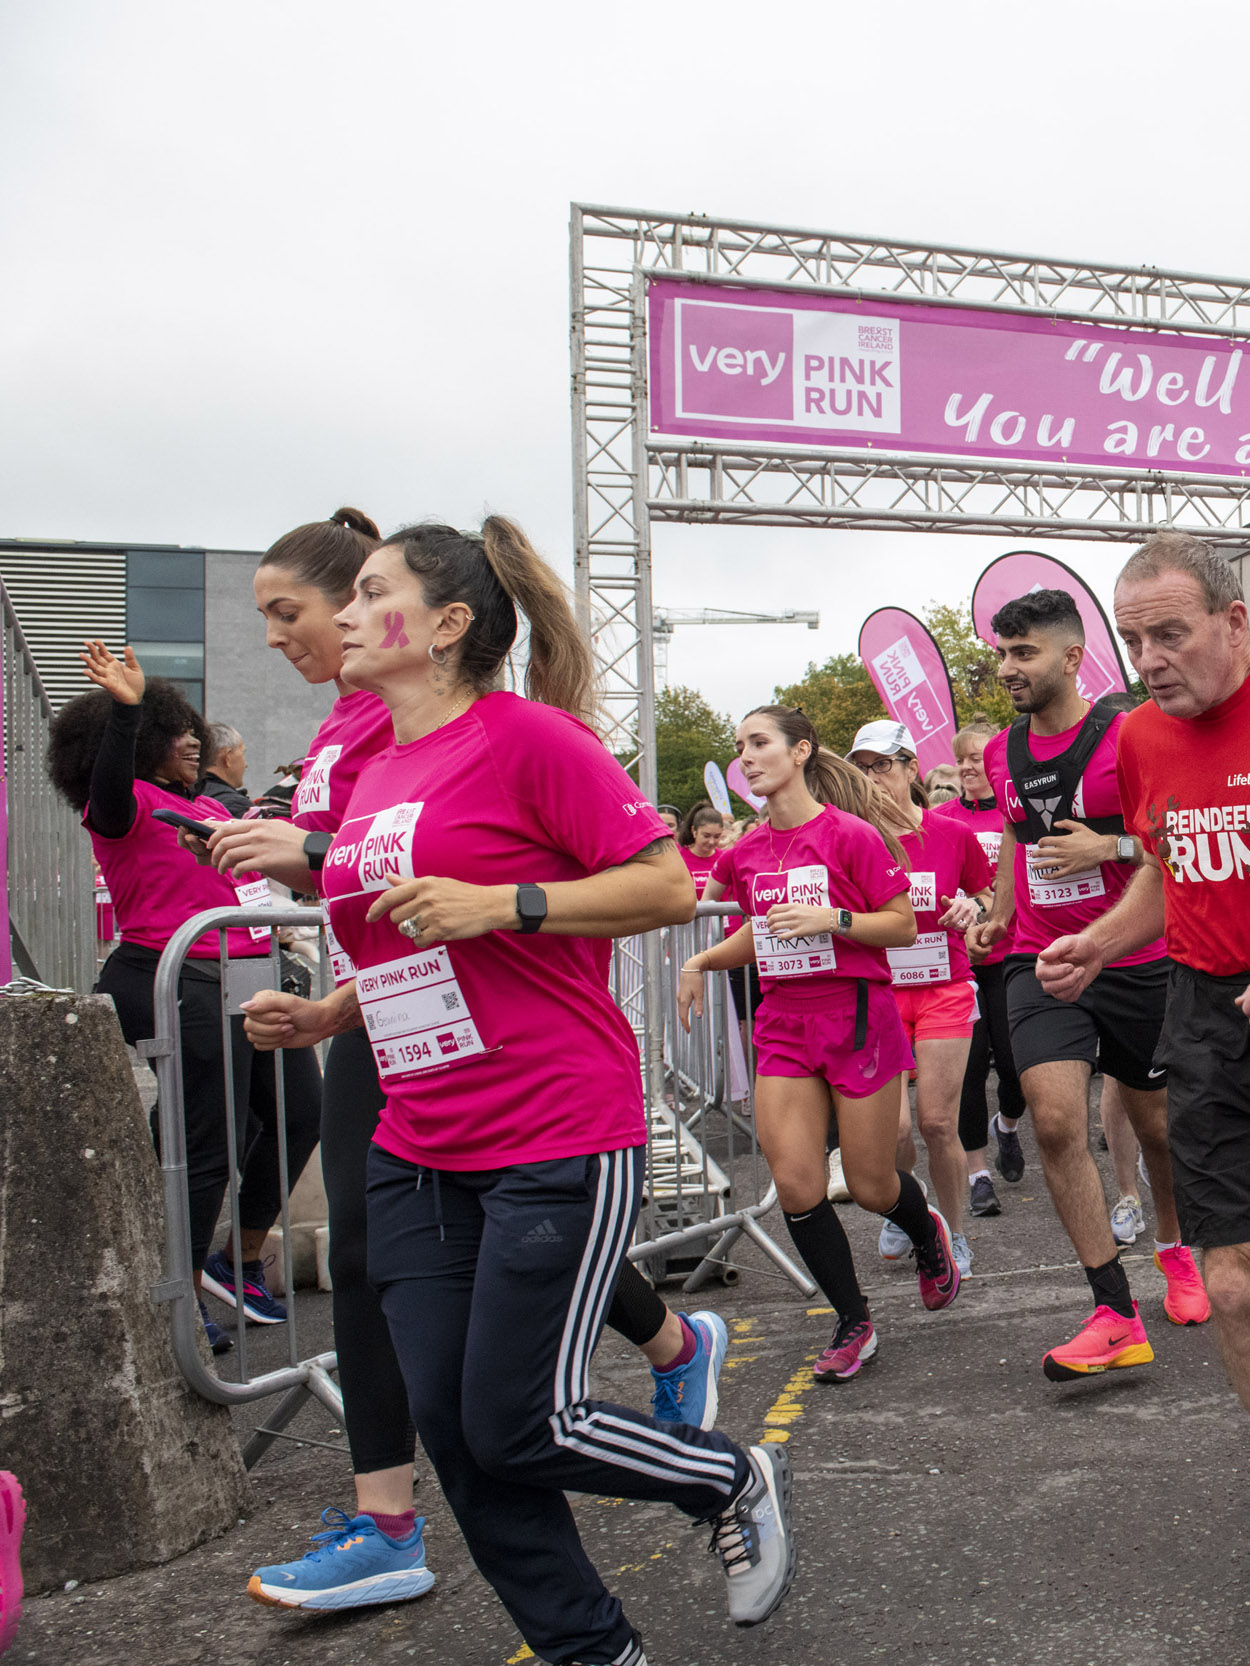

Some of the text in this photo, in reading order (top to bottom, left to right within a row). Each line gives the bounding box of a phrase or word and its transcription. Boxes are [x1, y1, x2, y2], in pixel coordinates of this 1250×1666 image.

[858, 333, 893, 343] CANCER
[858, 341, 894, 350] IRELAND
[689, 344, 786, 386] very
[804, 354, 894, 388] PINK
[804, 388, 882, 418] RUN
[944, 393, 1075, 448] You
[1103, 420, 1210, 460] are
[1024, 774, 1057, 790] EASYRUN
[365, 831, 407, 858] PINK
[326, 841, 362, 869] very
[363, 856, 400, 882] RUN
[755, 886, 786, 903] very
[791, 882, 824, 897] PINK
[911, 886, 932, 896] INK
[1044, 888, 1072, 900] 3123
[912, 897, 929, 907] UN
[925, 936, 942, 944] RUN
[778, 959, 803, 971] 3073
[359, 959, 441, 993] VERY PINK RUN
[900, 971, 925, 980] 6086
[399, 1042, 432, 1063] 1594
